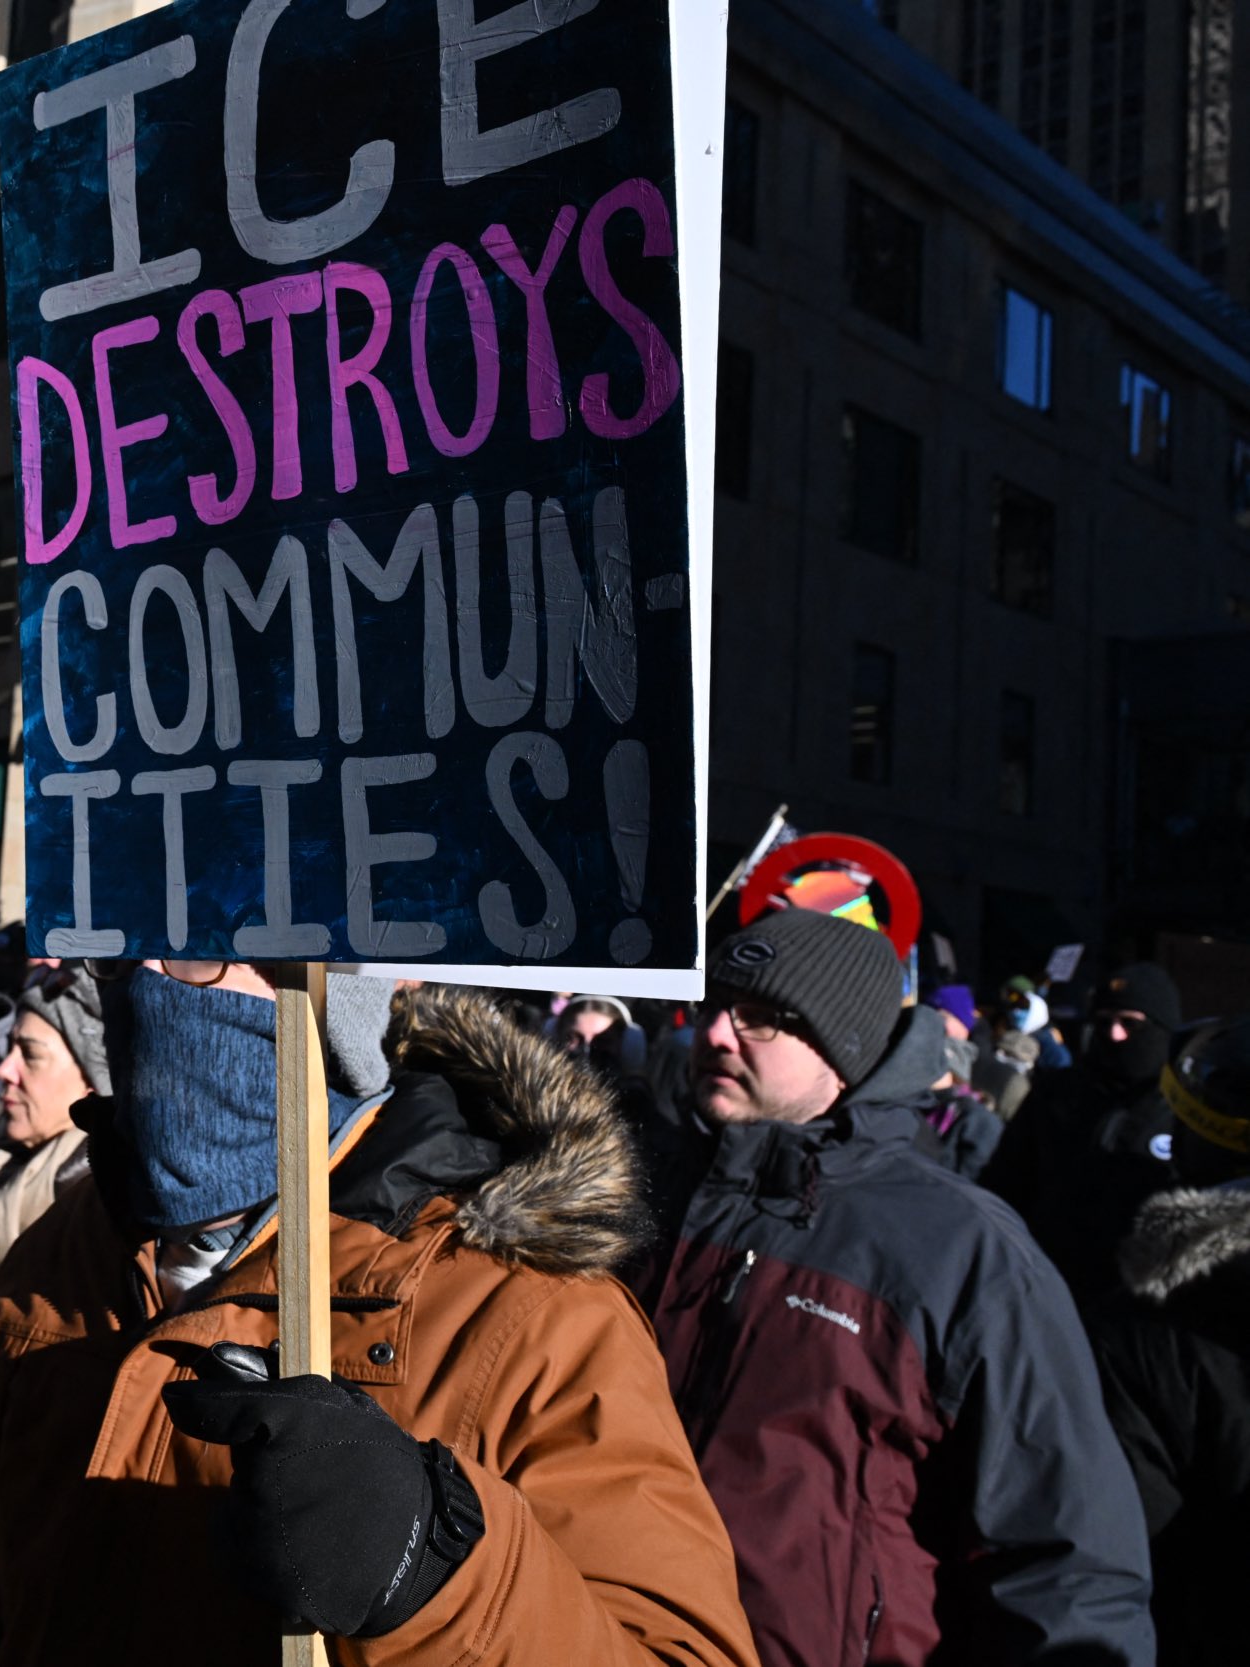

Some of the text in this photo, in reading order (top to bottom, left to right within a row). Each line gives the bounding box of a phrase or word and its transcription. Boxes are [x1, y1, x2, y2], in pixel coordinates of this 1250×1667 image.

[33, 0, 622, 321] ICE
[16, 177, 681, 565] DESTROYS
[39, 730, 651, 965] ITIES!
